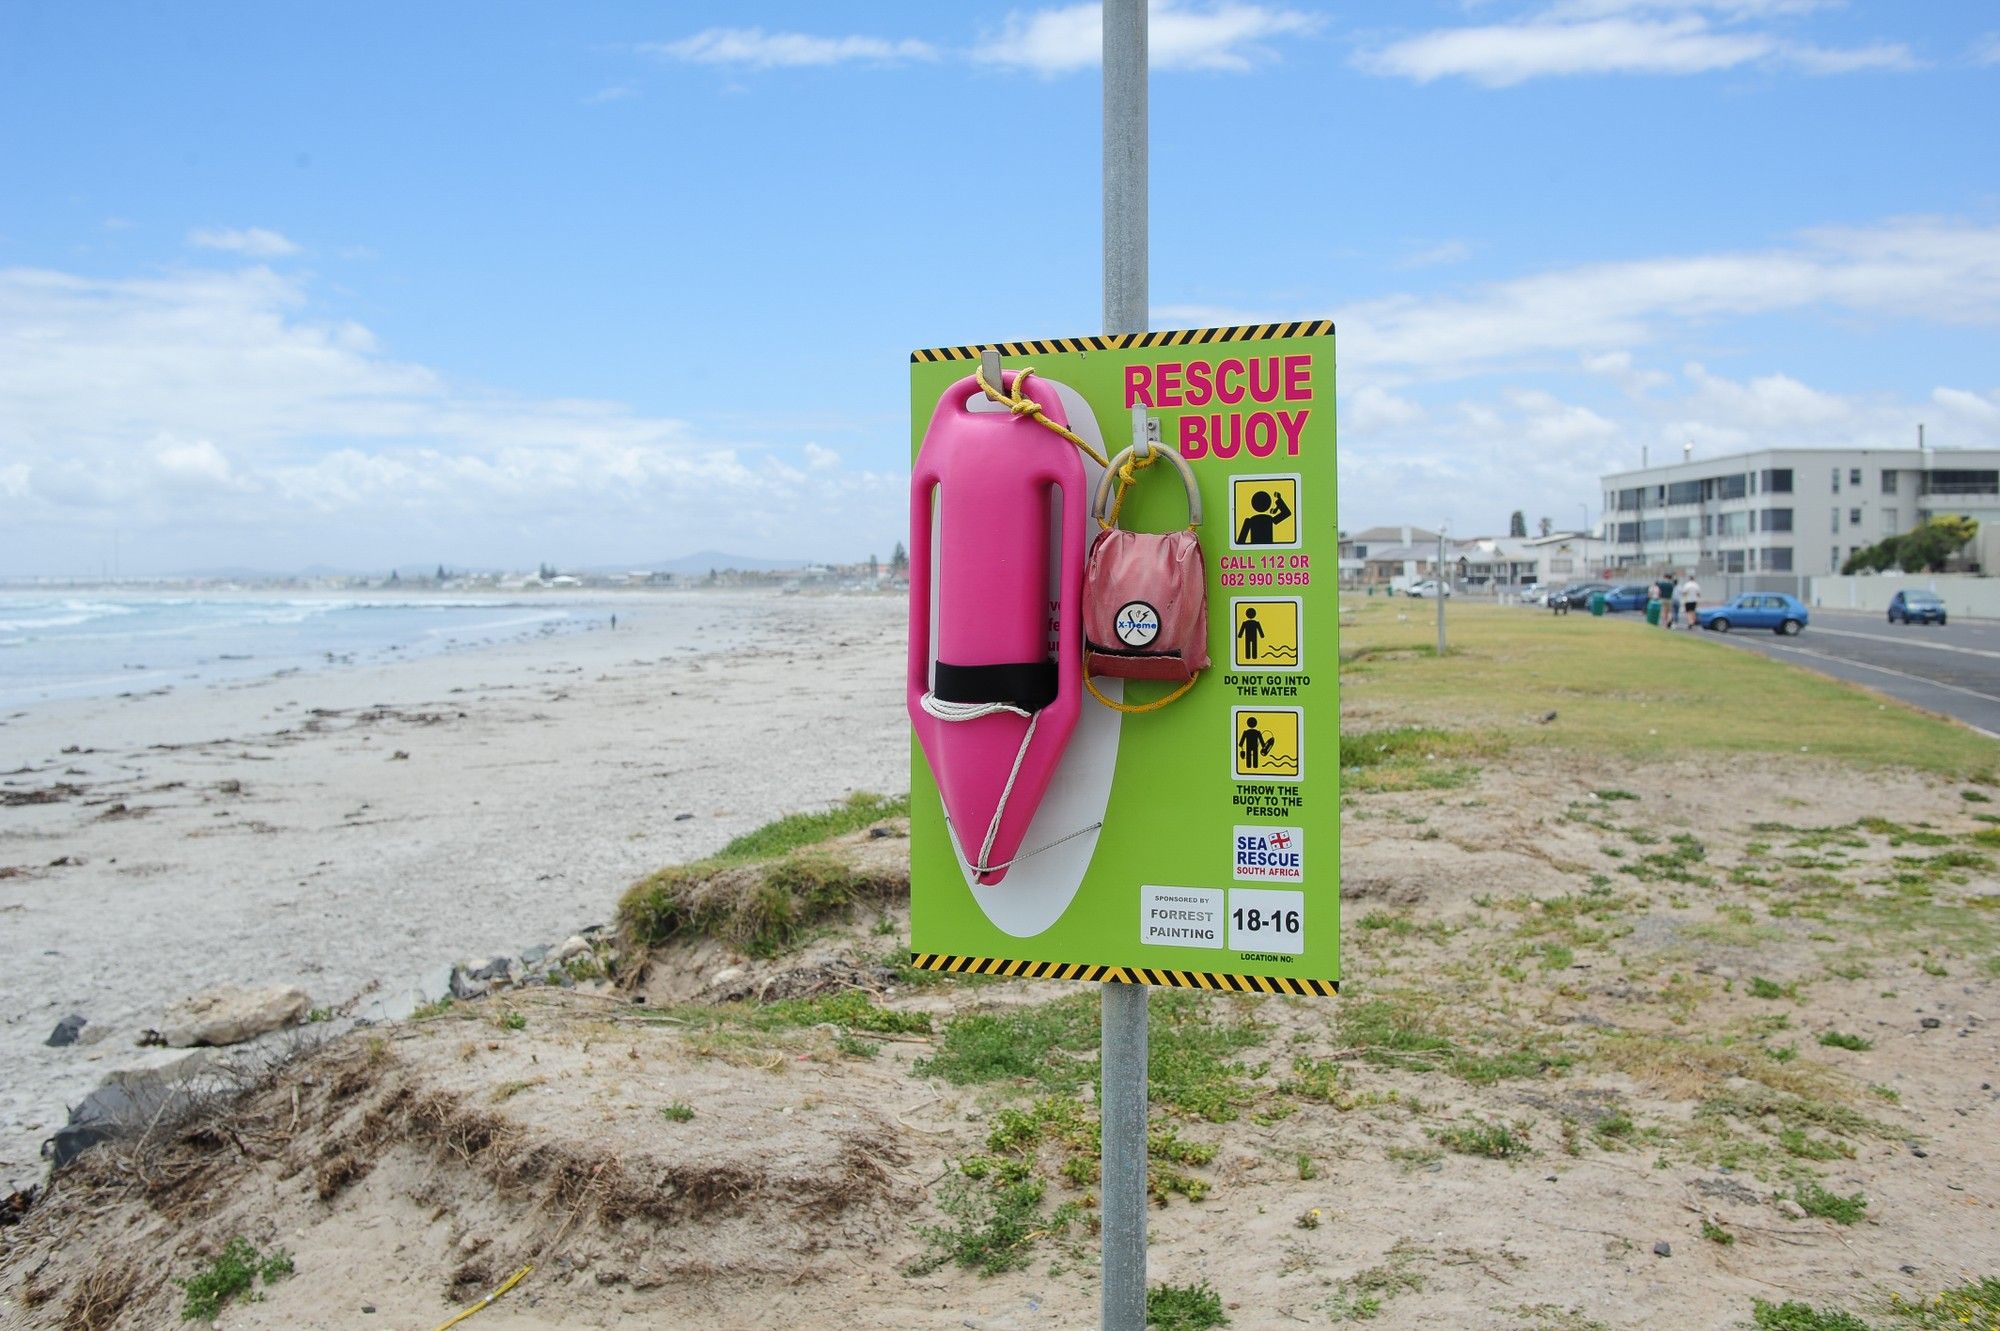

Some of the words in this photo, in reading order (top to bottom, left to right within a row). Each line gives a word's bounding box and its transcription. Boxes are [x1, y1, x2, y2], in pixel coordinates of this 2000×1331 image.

[1124, 354, 1312, 409] RESCUE
[1179, 410, 1311, 461] BUOY
[1220, 556, 1256, 569] CALL
[1260, 555, 1285, 569] 112
[1289, 555, 1309, 568] OR
[1221, 573, 1245, 586] 082
[1249, 572, 1273, 586] 990
[1277, 572, 1310, 586] 5958
[1224, 676, 1239, 685] DO
[1242, 676, 1264, 685] NOT
[1266, 676, 1282, 686] GO
[1285, 676, 1310, 686] INTO
[1237, 686, 1258, 696] THE
[1260, 686, 1298, 696] WATER
[1236, 785, 1274, 795] THROW
[1277, 786, 1298, 796] THE
[1232, 796, 1261, 806] BUOY
[1264, 796, 1278, 806] TO
[1281, 797, 1303, 807] THE
[1246, 806, 1289, 817] PERSON
[1237, 836, 1268, 851] SEA
[1237, 852, 1300, 867] RESCUE
[1236, 866, 1266, 876] SOUTH
[1268, 868, 1300, 877] AFRICA
[1155, 895, 1198, 904] SPONSORED
[1151, 908, 1214, 922] FORREST
[1233, 908, 1300, 934] 18-16
[1150, 926, 1214, 940] PAINTING
[1240, 952, 1278, 962] LOCATION
[1280, 955, 1294, 963] NO:
